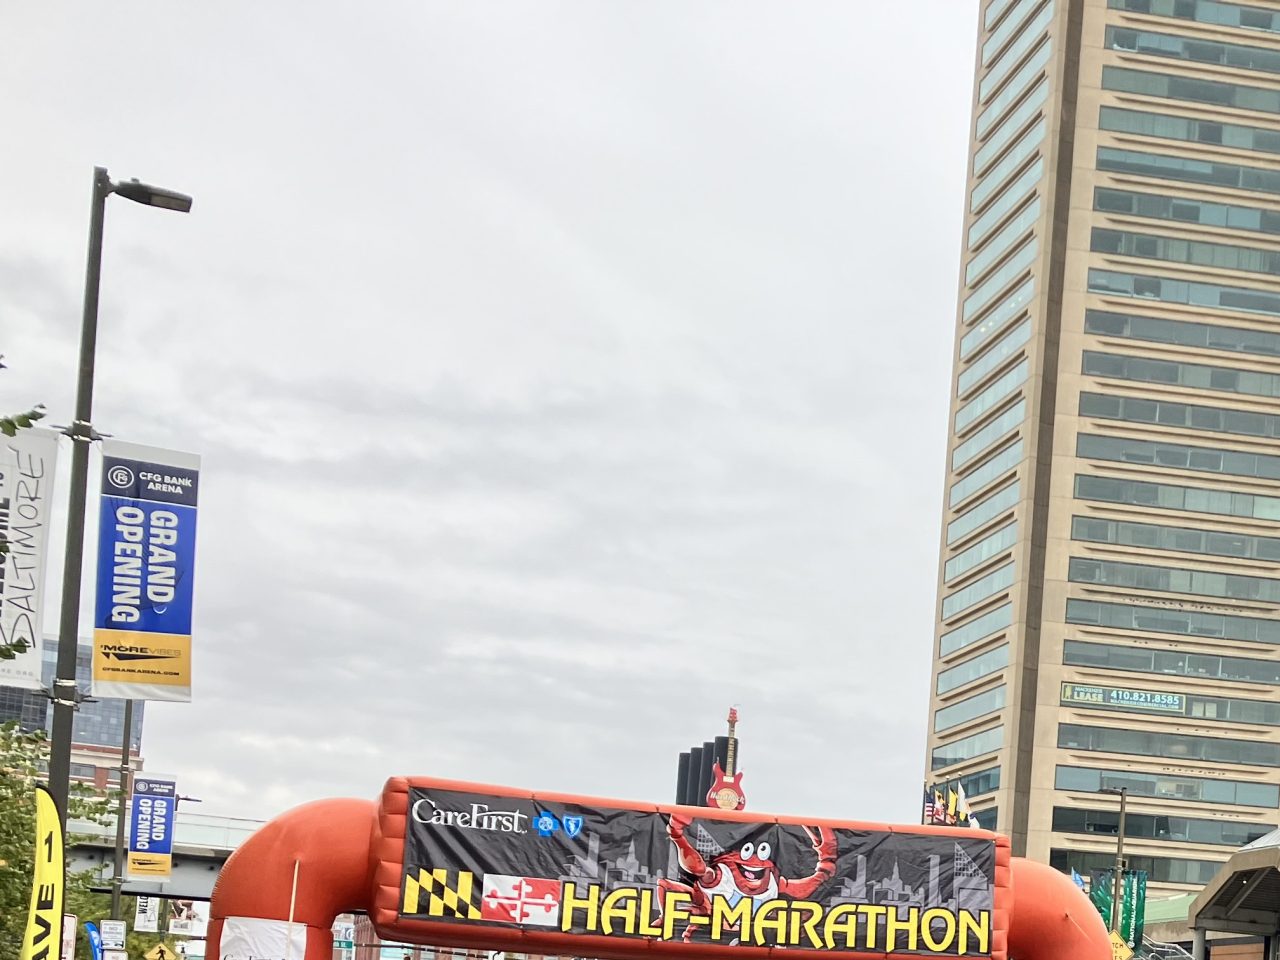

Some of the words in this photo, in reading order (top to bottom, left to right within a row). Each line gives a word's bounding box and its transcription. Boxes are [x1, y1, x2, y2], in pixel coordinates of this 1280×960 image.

[139, 471, 162, 482] CFG
[164, 475, 192, 487] BANK
[147, 482, 184, 495] ARENA
[111, 506, 145, 623] OPENING
[146, 510, 179, 605] GRAND
[1073, 691, 1104, 702] LEASE
[1110, 690, 1180, 706] 410.821.8585
[136, 798, 153, 850] OPENING
[151, 799, 167, 841] GRAND
[411, 797, 529, 835] CareFirst
[44, 830, 54, 863] 1
[560, 882, 990, 955] HALF-MARATHON
